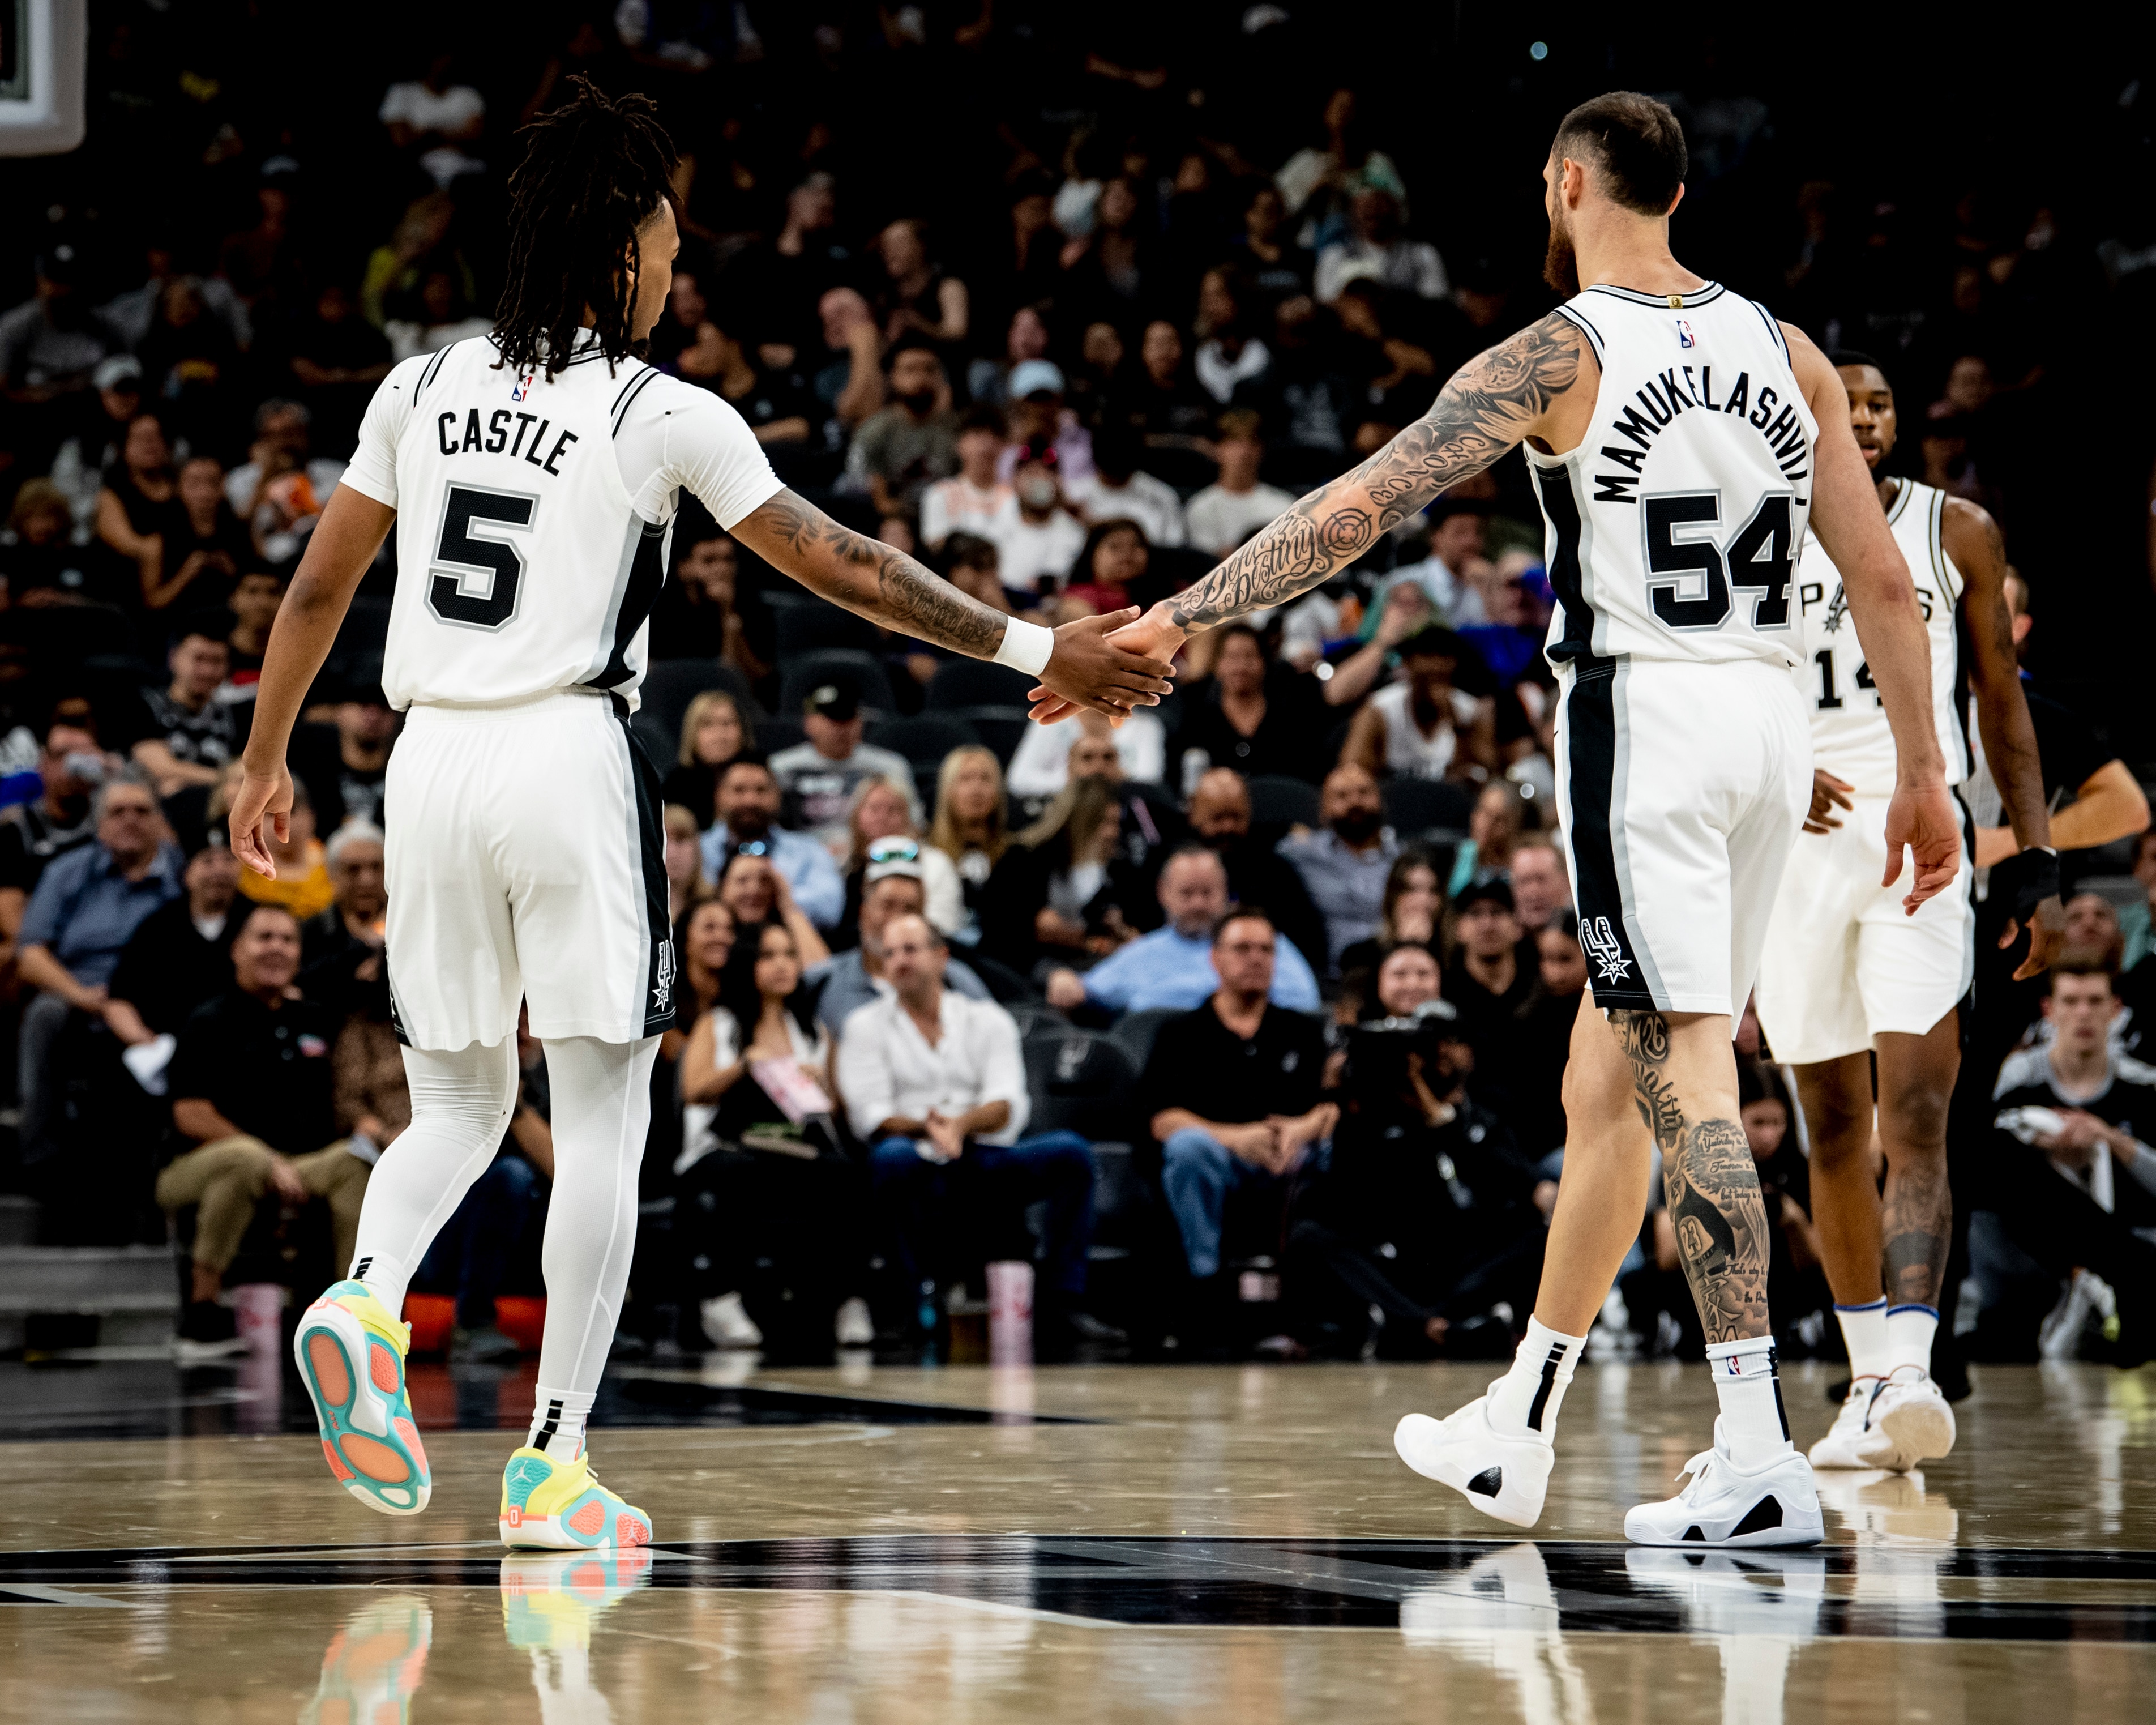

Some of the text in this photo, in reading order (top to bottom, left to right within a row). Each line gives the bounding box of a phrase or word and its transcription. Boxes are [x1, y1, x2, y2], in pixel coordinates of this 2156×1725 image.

[438, 408, 579, 477] CASTLE
[423, 480, 541, 634] 5
[1217, 520, 1325, 609] Destiny
[1640, 488, 1798, 633] 54
[1679, 1219, 1702, 1258] 23
